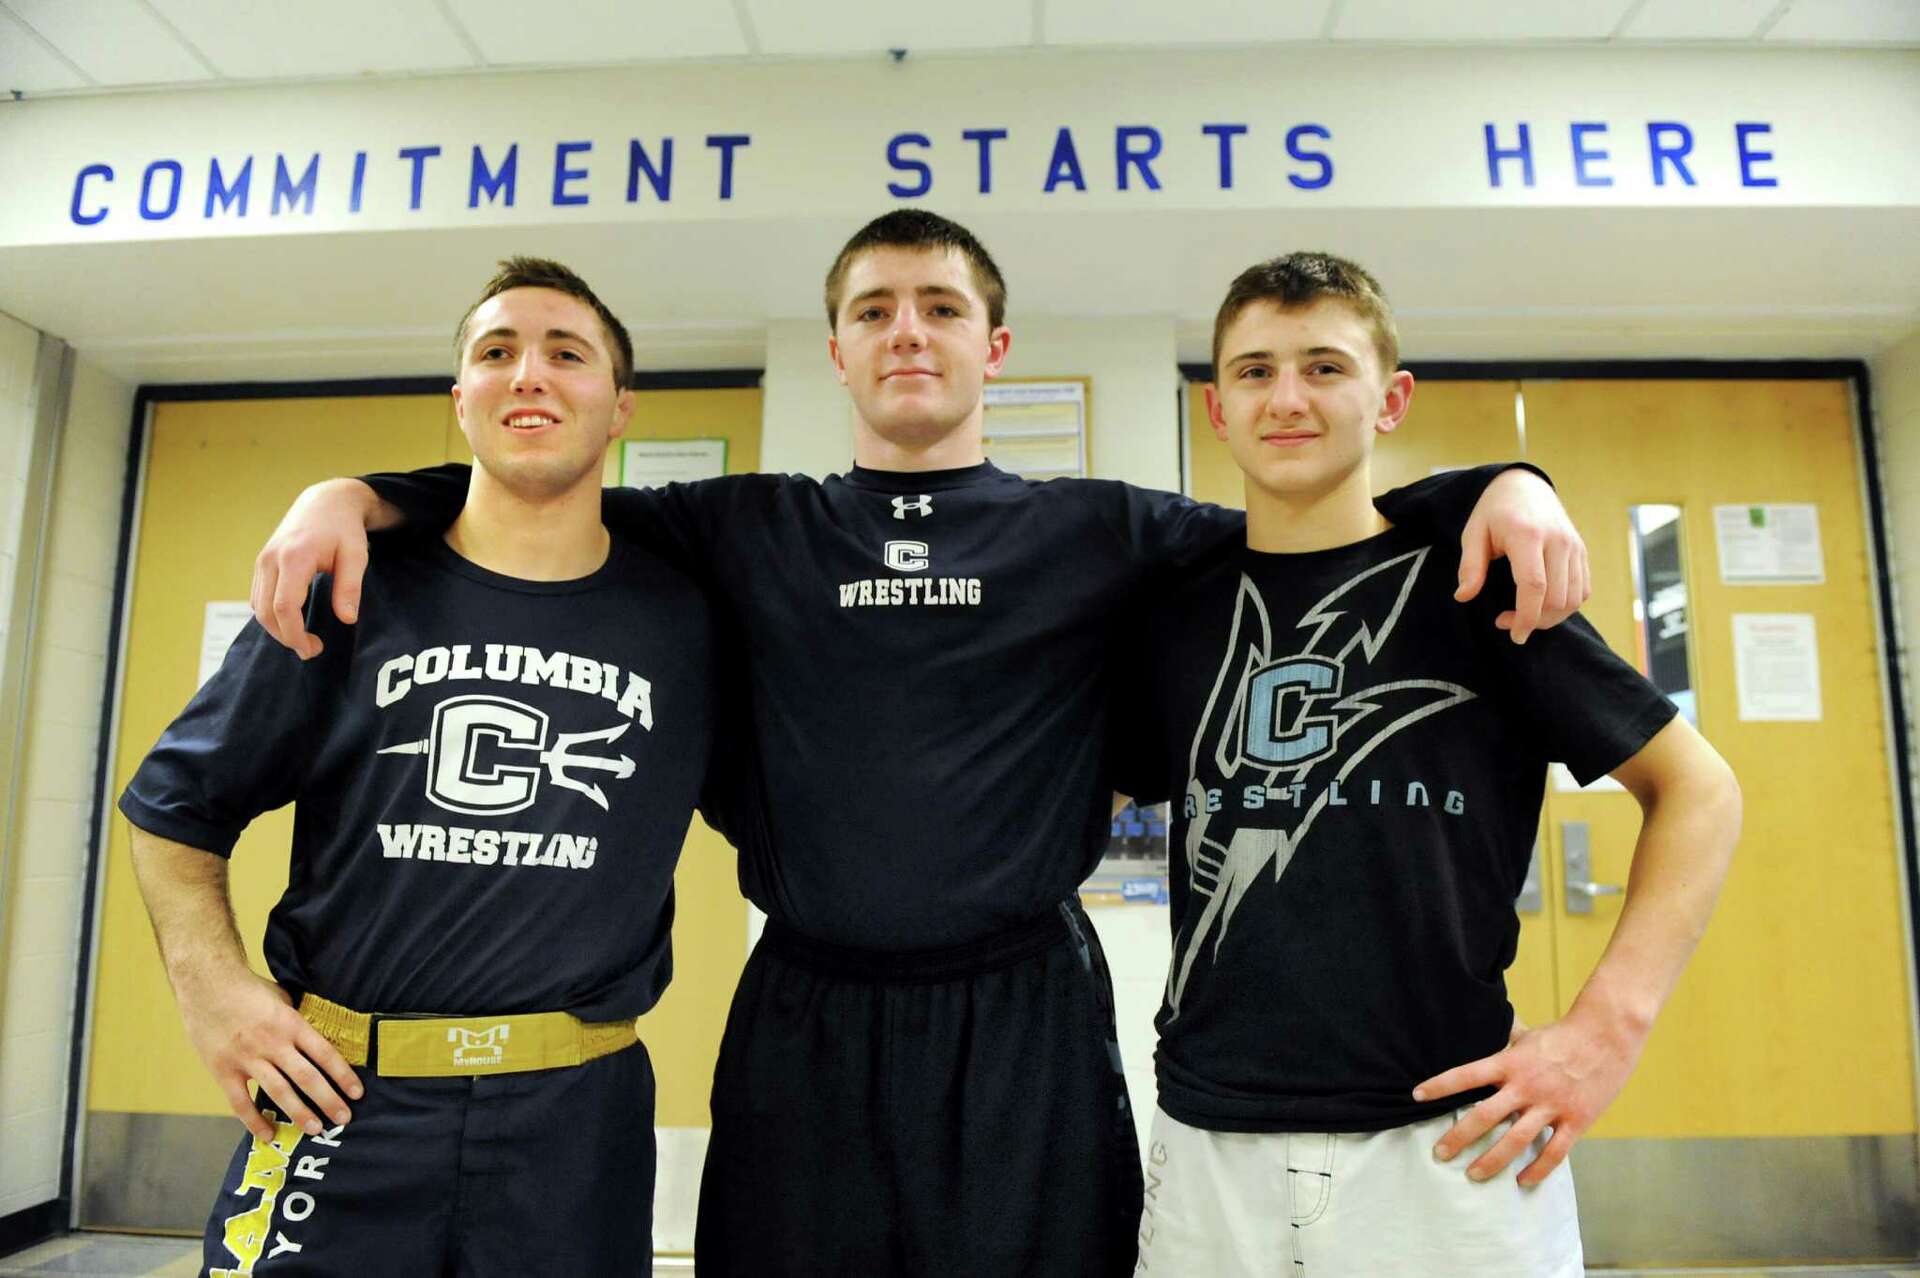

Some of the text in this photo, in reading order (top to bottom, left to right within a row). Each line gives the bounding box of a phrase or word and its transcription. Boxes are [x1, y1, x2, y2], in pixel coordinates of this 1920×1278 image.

[70, 122, 1779, 226] COMMITMENT STARTS HERE
[884, 540, 929, 572] C
[839, 577, 982, 608] WRESTLING
[375, 643, 654, 732] COLUMBIA
[425, 694, 549, 816] C
[1184, 779, 1465, 819] RESTLING
[376, 823, 598, 870] WRESTLING
[267, 1125, 345, 1260] YORK
